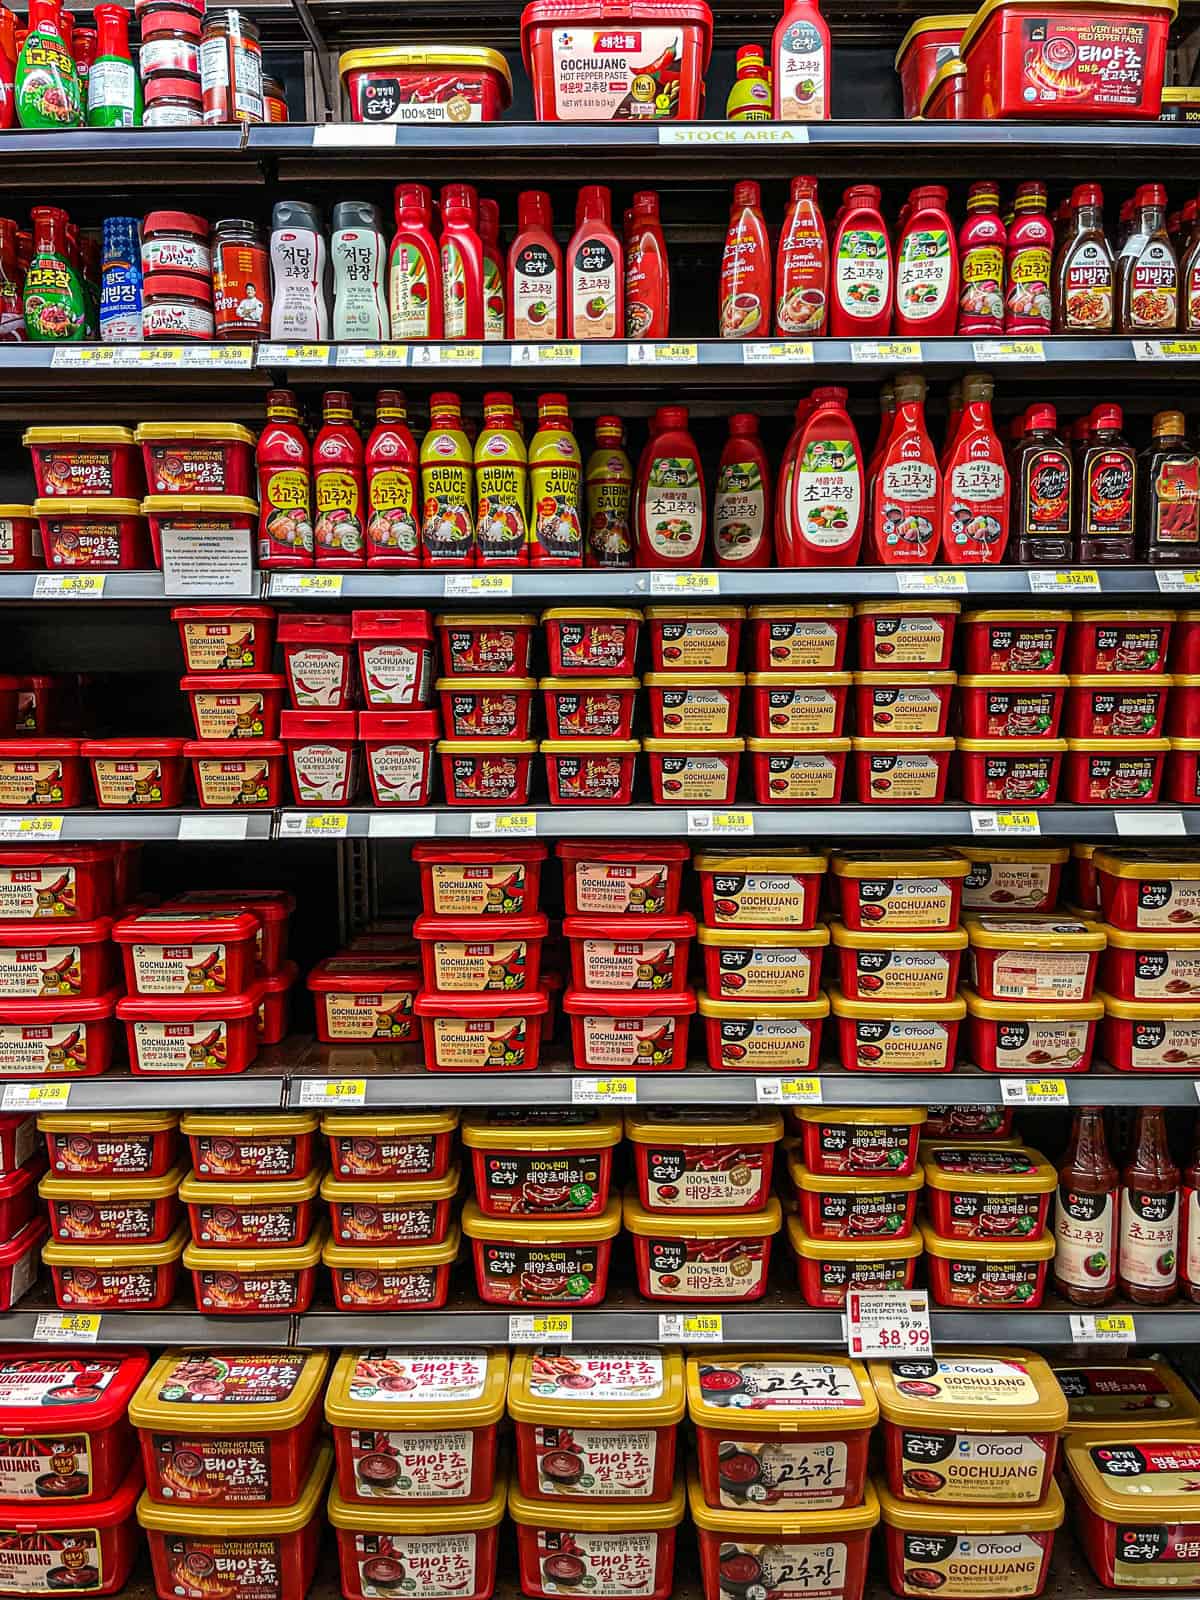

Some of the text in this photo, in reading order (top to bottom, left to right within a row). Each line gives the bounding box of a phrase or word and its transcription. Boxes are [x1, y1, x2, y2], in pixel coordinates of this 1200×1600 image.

[1091, 24, 1144, 35] VERY HOT RICE
[600, 35, 636, 50] 해찬들
[1078, 46, 1141, 69] 태양초
[560, 58, 627, 71] GOCHUJANG
[560, 71, 628, 81] HOT PEPPER PASTE
[368, 98, 395, 115] 순창
[401, 106, 444, 120] 100%현미
[675, 131, 794, 141] STOCK AREA
[283, 247, 311, 265] 저당
[345, 247, 371, 265] 저당
[286, 266, 310, 279] 고추장
[347, 265, 371, 281] 쌈장
[843, 267, 883, 281] 초고추장
[903, 267, 944, 284] 초고추장
[1071, 269, 1110, 285] 비빔장
[1136, 269, 1175, 285] 비빔장
[431, 470, 463, 480] BIBIM
[483, 470, 514, 480] BIBIM
[550, 470, 577, 480] BIBIM
[428, 482, 466, 494] SAUCE
[480, 482, 517, 494] SAUCE
[545, 482, 578, 494] SAUCE
[887, 474, 934, 490] 초고추장
[956, 474, 1001, 490] 초고추장
[803, 484, 854, 502] 초고추장
[651, 498, 697, 515] 초고추장
[718, 504, 758, 520] 초고추장
[79, 535, 120, 551] 태양초
[72, 579, 95, 588] $3.99
[687, 577, 709, 586] $2.99
[683, 639, 726, 648] GOCHUJANG
[368, 657, 414, 665] GOCHUJANG
[683, 706, 726, 714] GOCHUJANG
[297, 756, 344, 764] GOCHUJANG
[683, 772, 726, 780] GOCHUJANG
[29, 821, 53, 830] $3.99
[439, 881, 483, 889] GOCHUJANG
[582, 879, 625, 887] GOCHUJANG
[740, 896, 799, 906] GOCHUJANG
[887, 899, 946, 910] GOCHUJANG
[441, 958, 484, 966] GOCHUJANG
[589, 956, 633, 965] GOCHUJANG
[747, 970, 805, 979] GOCHUJANG
[885, 971, 944, 982] GOCHUJANG
[142, 1038, 184, 1046] GOCHUJANG
[441, 1034, 485, 1042] GOCHUJANG
[590, 1033, 633, 1041] GOCHUJANG
[748, 1041, 805, 1050] GOCHUJANG
[884, 1041, 942, 1052] GOCHUJANG
[38, 1087, 61, 1097] $7.99
[335, 1084, 357, 1095] $7.99
[606, 1082, 628, 1092] $7.99
[97, 1143, 147, 1159] 태양초
[239, 1145, 289, 1161] 태양초
[382, 1144, 429, 1160] 태양초
[652, 1165, 680, 1180] 순창
[685, 1174, 728, 1186] 100%현미
[99, 1210, 148, 1226] 태양초
[241, 1213, 291, 1230] 태양초
[382, 1211, 430, 1227] 태양초
[1128, 1222, 1173, 1242] 초고추장
[654, 1255, 681, 1271] 순창
[687, 1264, 728, 1275] 100%현미
[102, 1272, 151, 1289] 태양초
[383, 1274, 431, 1291] 태양초
[243, 1279, 294, 1296] 태양초
[69, 1319, 91, 1330] $6.99
[542, 1320, 568, 1330] $17.99
[900, 1320, 922, 1329] $9.99
[879, 1328, 930, 1347] $8.99
[411, 1361, 480, 1376] 태양초
[587, 1360, 656, 1375] 태양초
[229, 1366, 297, 1384] 태양초
[760, 1372, 850, 1396] 고추장
[944, 1377, 1026, 1387] GOCHUJANG
[202, 1447, 265, 1455] RED PEPPER PASTE
[213, 1441, 265, 1449] VERY HOT RICE
[906, 1440, 1023, 1457] 순창 O'food
[204, 1457, 266, 1476] 태양초
[404, 1453, 467, 1472] 태양초
[588, 1451, 649, 1469] 태양초
[778, 1456, 841, 1487] 고추장
[948, 1465, 1038, 1480] GOCHUJANG
[1107, 1459, 1142, 1476] 순창
[432, 1470, 464, 1482] 고추장
[614, 1469, 647, 1481] 고추장
[223, 1542, 274, 1550] VERY HOT RICE
[977, 1541, 1022, 1555] O'food
[214, 1558, 277, 1577] 태양초
[408, 1555, 469, 1574] 태양초
[590, 1554, 650, 1572] 태양초
[949, 1561, 1035, 1576] GOCHUJANG
[435, 1572, 465, 1584] 고추장
[616, 1571, 647, 1583] 고추장
[778, 1557, 841, 1588] 고추장
